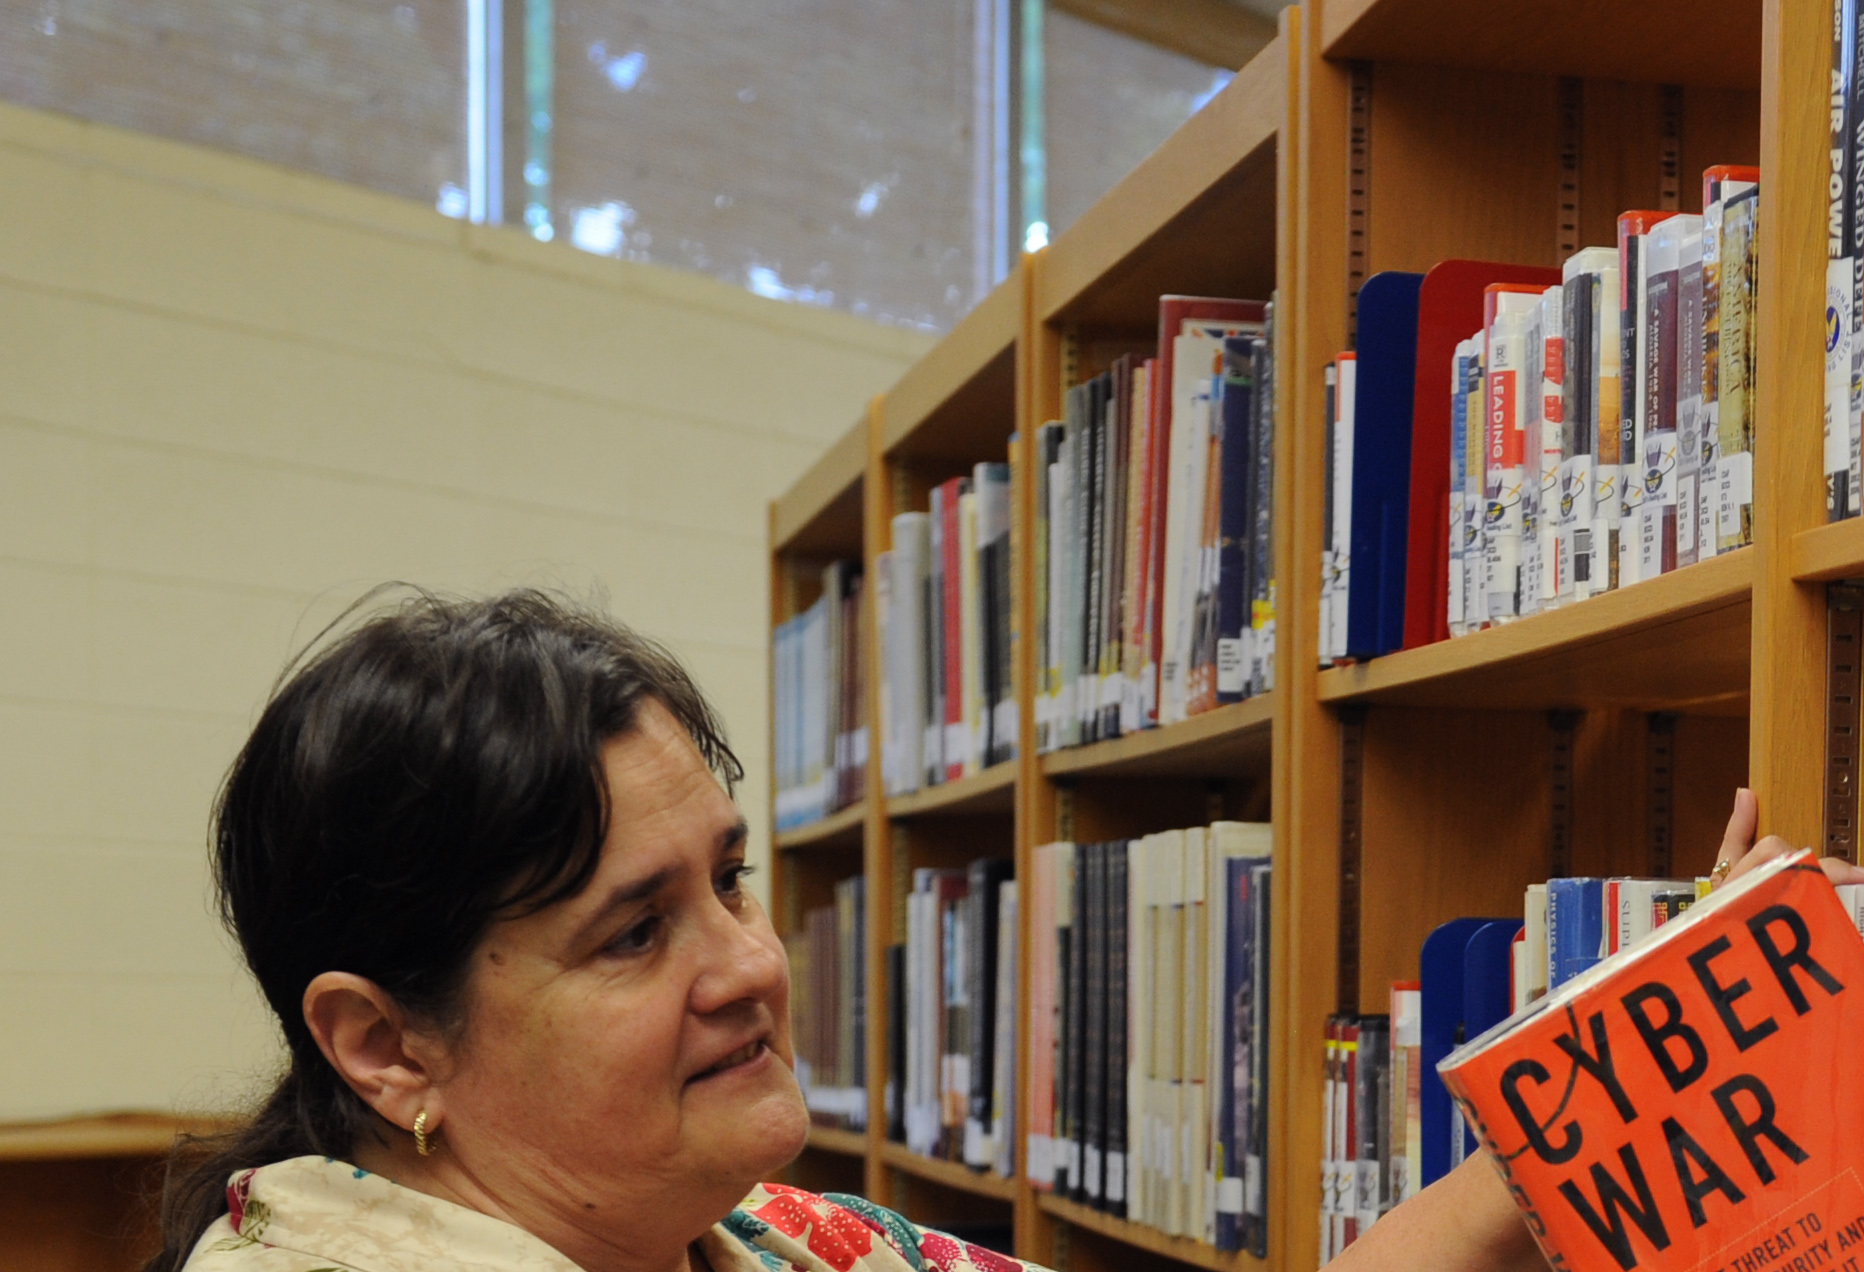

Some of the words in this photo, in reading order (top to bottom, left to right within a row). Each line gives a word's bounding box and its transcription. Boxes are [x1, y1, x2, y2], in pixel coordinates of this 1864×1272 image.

[1829, 68, 1845, 134] AIR
[1828, 148, 1845, 259] POWE
[1492, 375, 1504, 459] LEADING
[1549, 892, 1557, 955] PHYSICS
[1549, 957, 1556, 978] OF
[1500, 904, 1845, 1165] CYBER
[1558, 1073, 1810, 1272] WAR
[1796, 1212, 1822, 1243] TO
